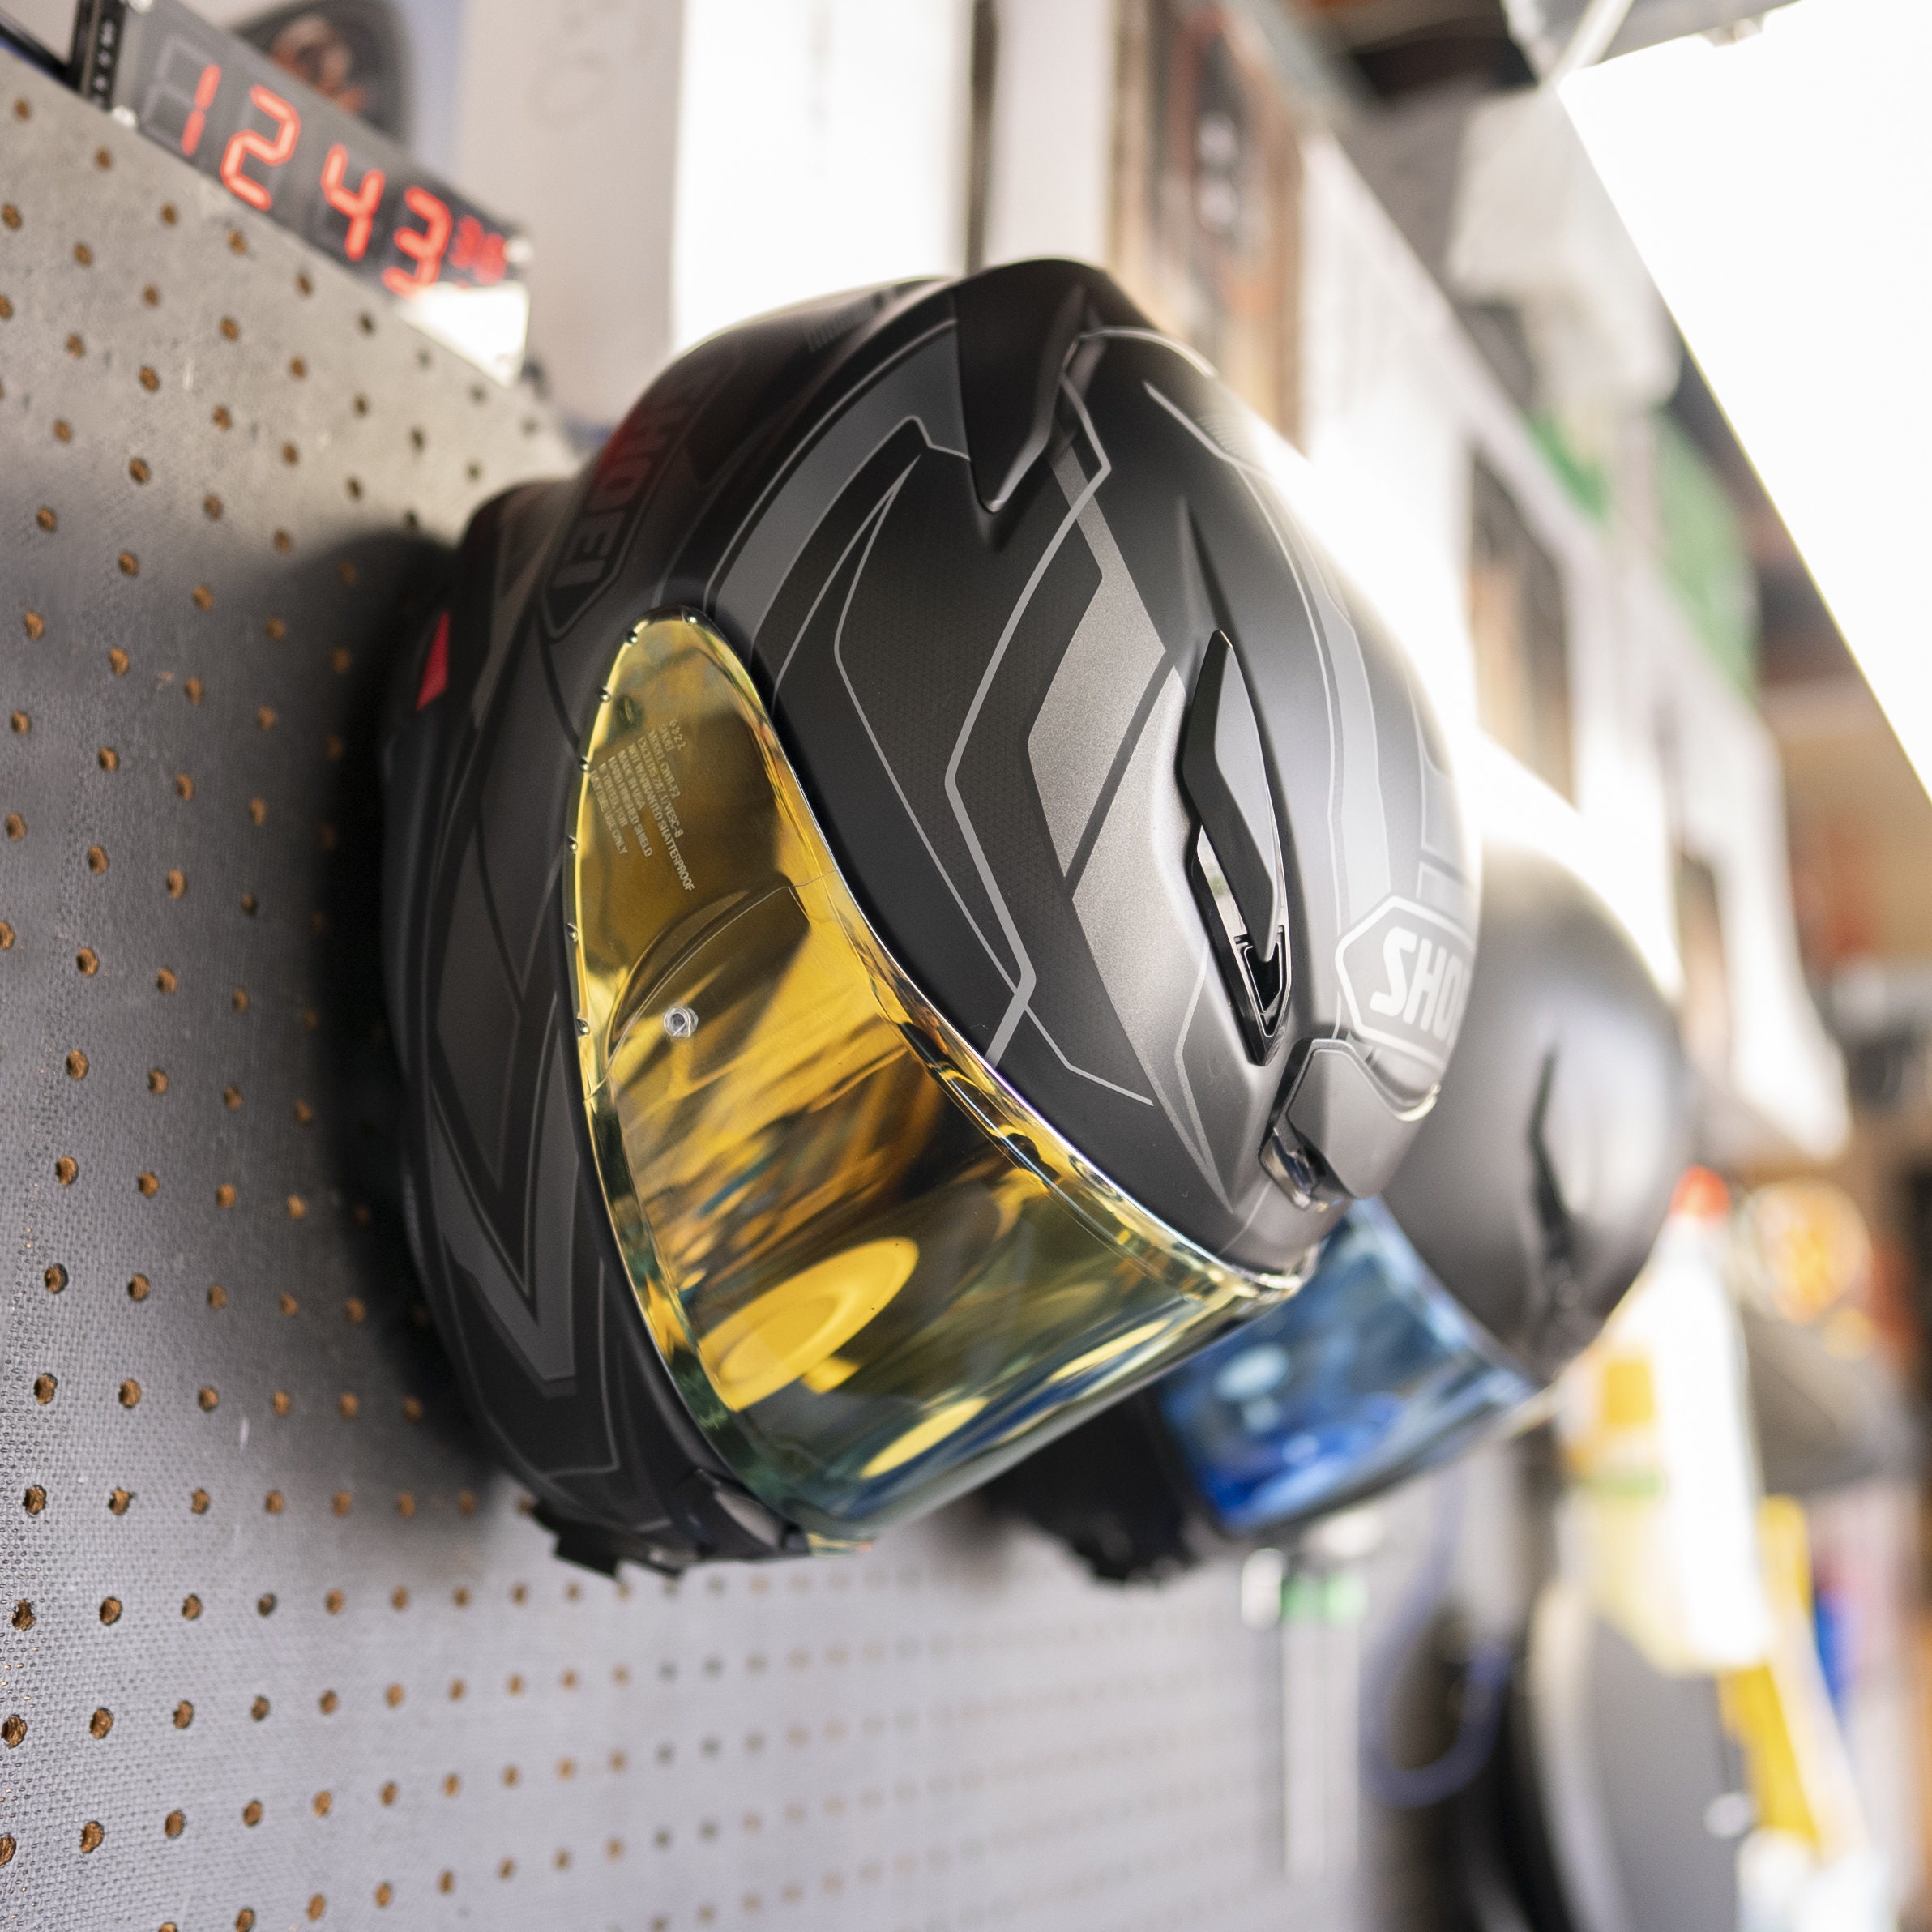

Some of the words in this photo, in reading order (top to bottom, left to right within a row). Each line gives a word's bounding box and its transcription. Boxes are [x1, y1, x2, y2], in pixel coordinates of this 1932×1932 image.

[611, 827, 628, 854] ONLY
[633, 823, 653, 857] SHIELD
[635, 762, 663, 821] WARRANTED
[657, 819, 695, 891] SHATTERPROOF
[1370, 926, 1468, 1045] SHO
